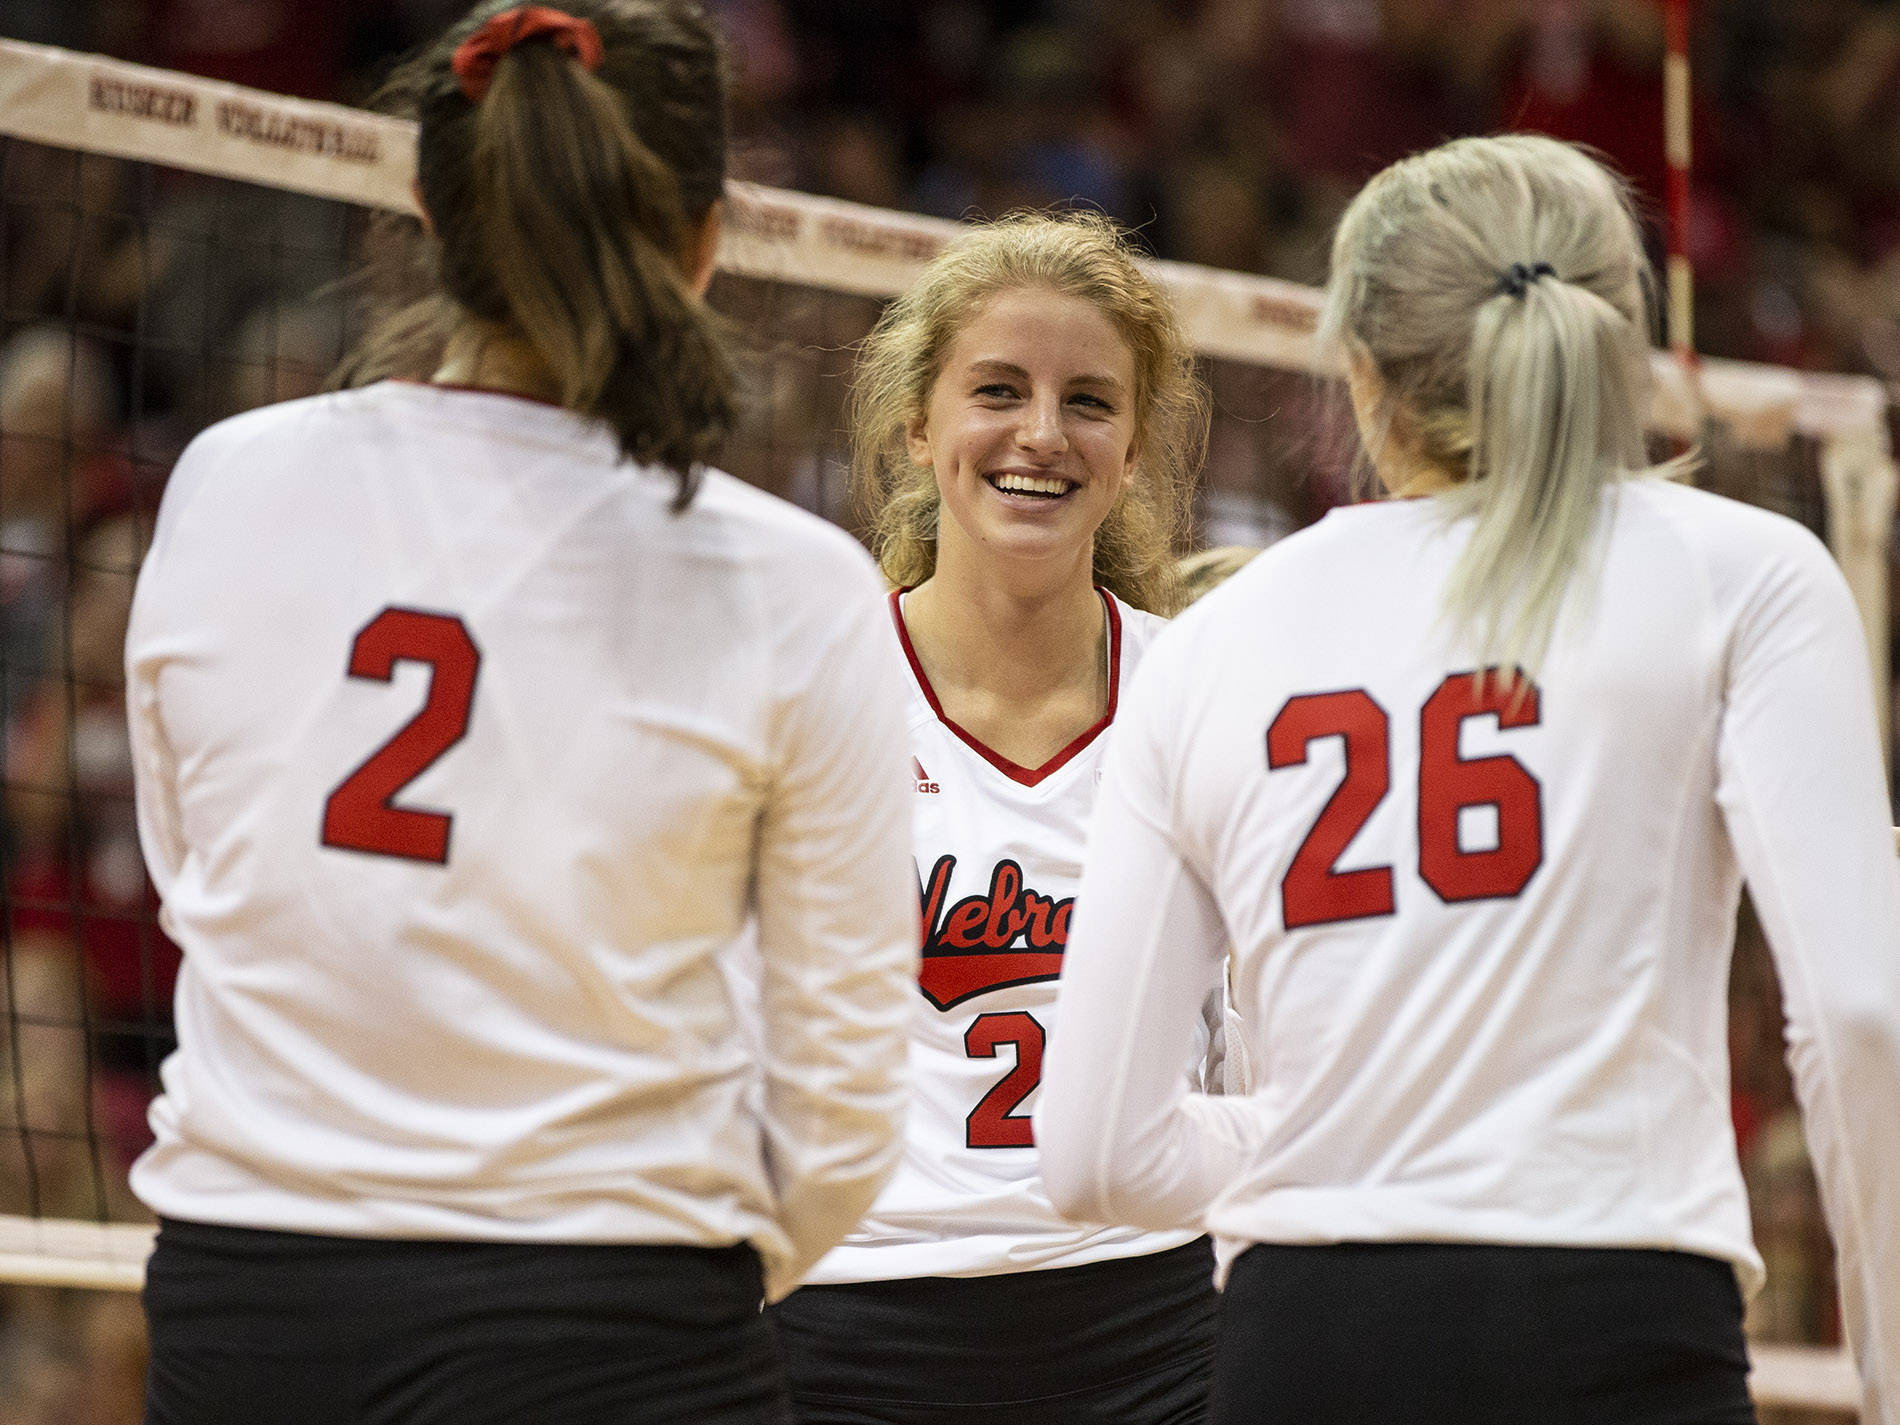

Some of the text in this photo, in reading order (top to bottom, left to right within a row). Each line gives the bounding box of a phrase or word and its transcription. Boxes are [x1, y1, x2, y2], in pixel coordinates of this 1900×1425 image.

[320, 604, 482, 865] 2
[1266, 662, 1544, 931] 26
[963, 1010, 1046, 1149] 2
